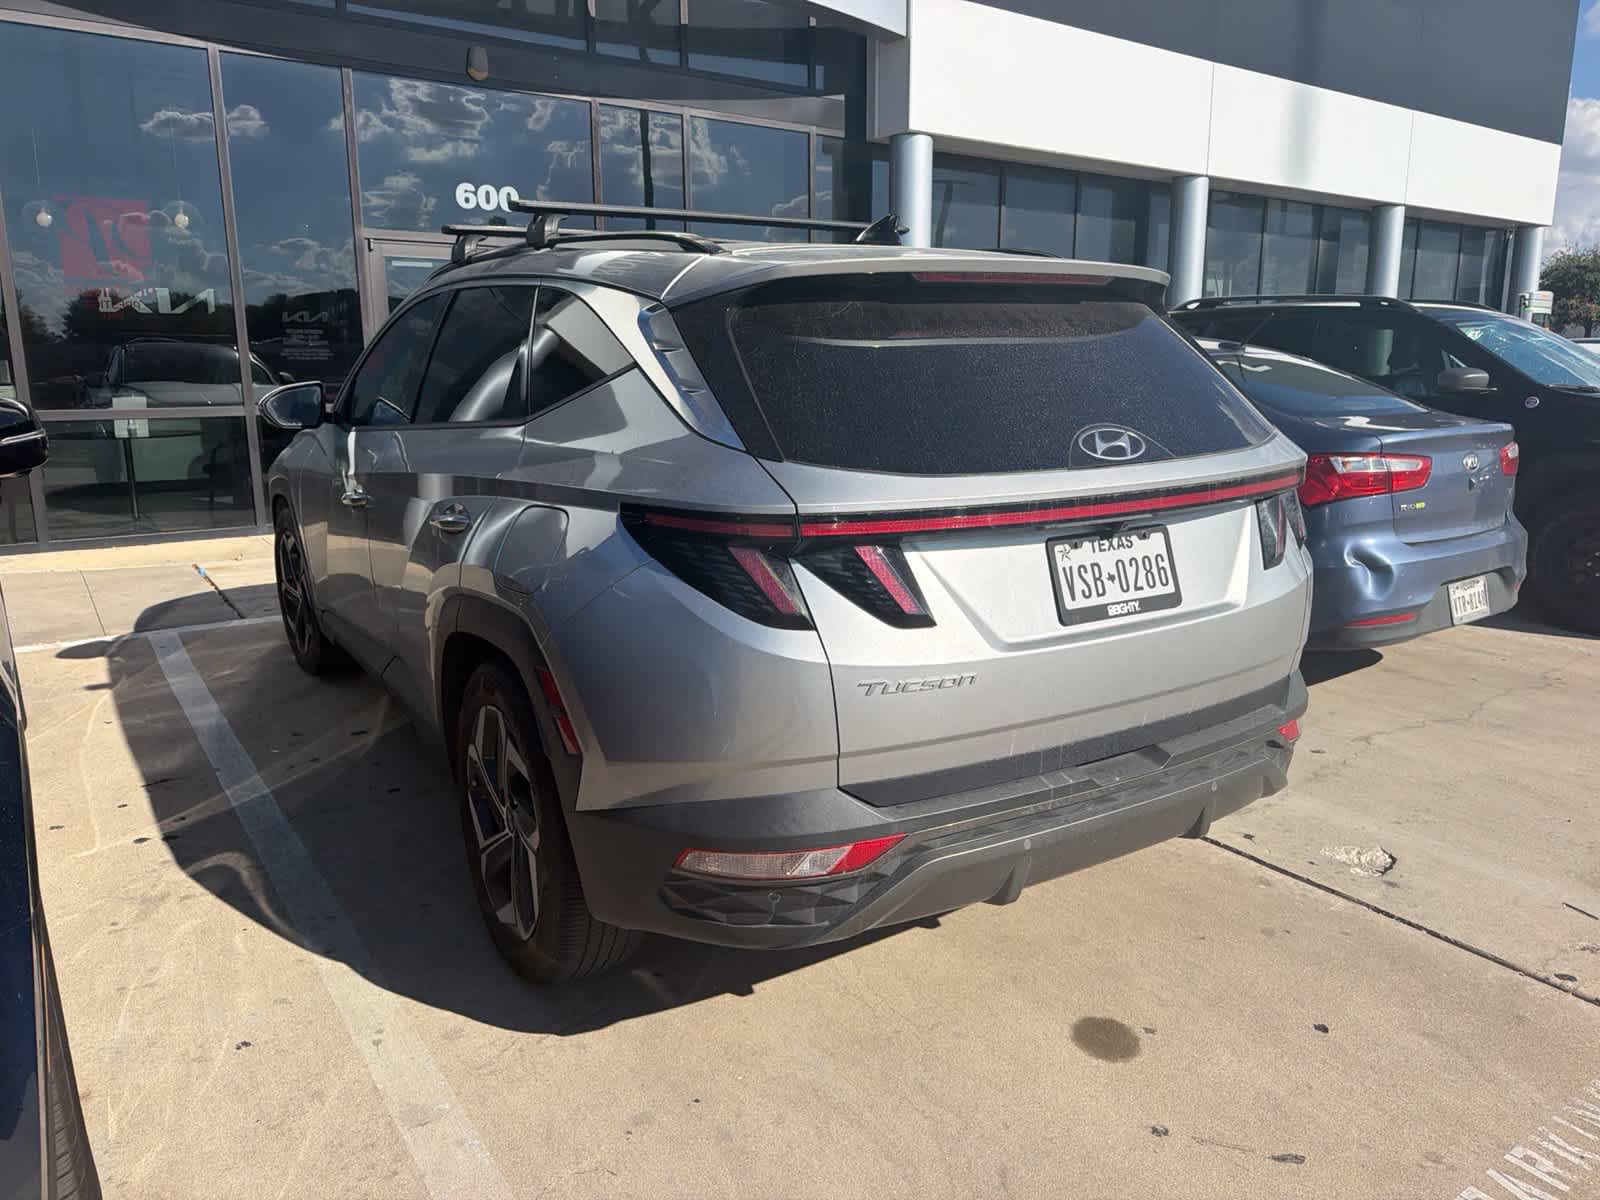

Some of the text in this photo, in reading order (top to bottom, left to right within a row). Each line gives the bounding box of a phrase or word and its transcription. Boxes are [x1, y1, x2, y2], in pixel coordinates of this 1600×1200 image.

[456, 182, 519, 212] 600
[1090, 536, 1133, 553] TEXAS
[857, 674, 977, 697] TUCSON
